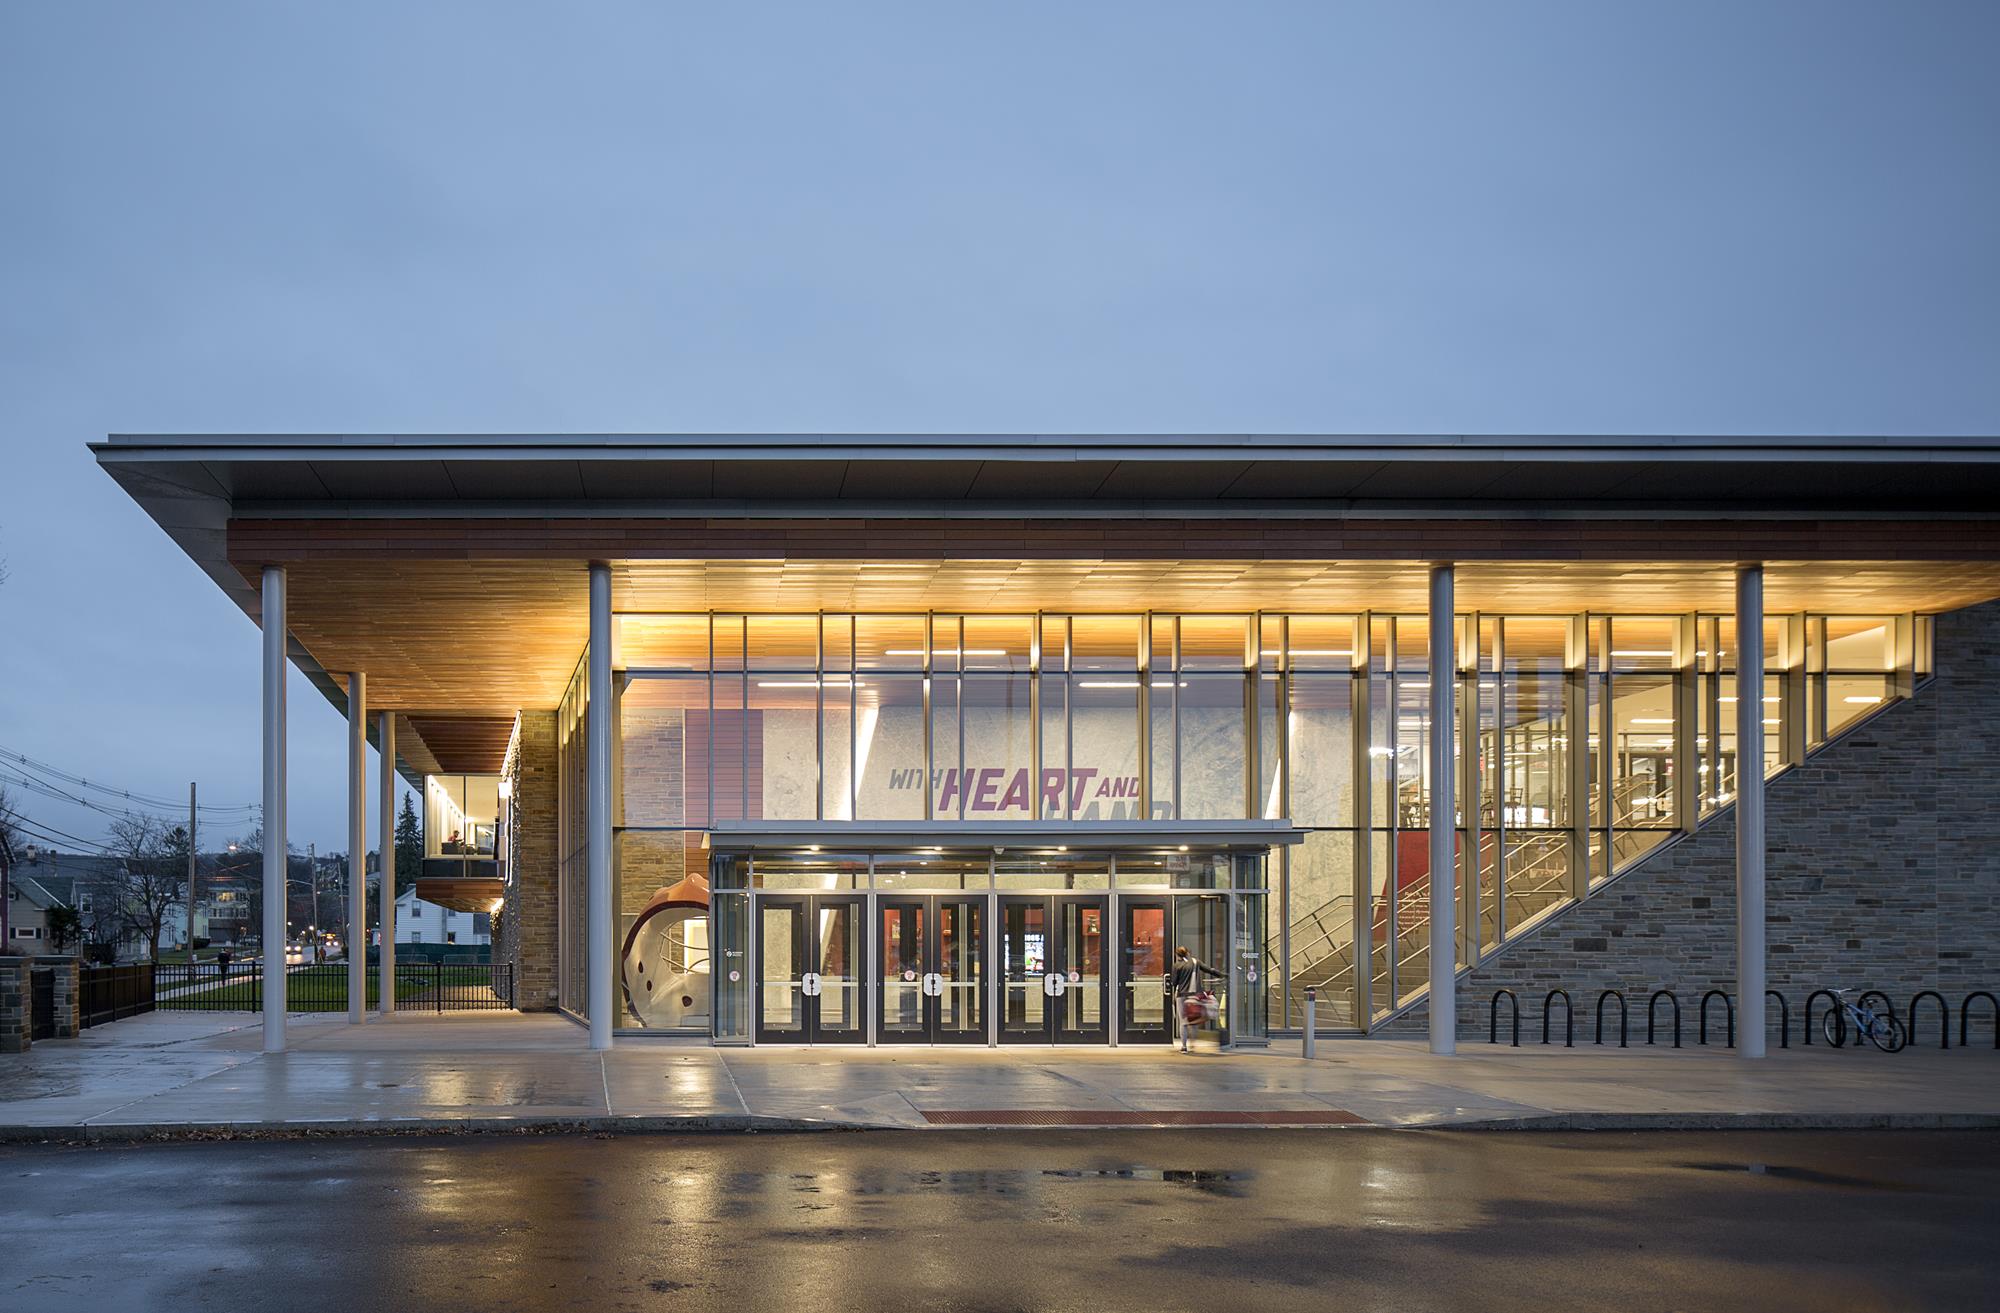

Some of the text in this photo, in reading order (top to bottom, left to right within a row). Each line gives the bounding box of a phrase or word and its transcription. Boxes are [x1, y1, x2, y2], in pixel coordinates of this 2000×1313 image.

[889, 768, 943, 789] WITH
[938, 767, 1099, 811] HEART
[1095, 776, 1140, 798] AND
